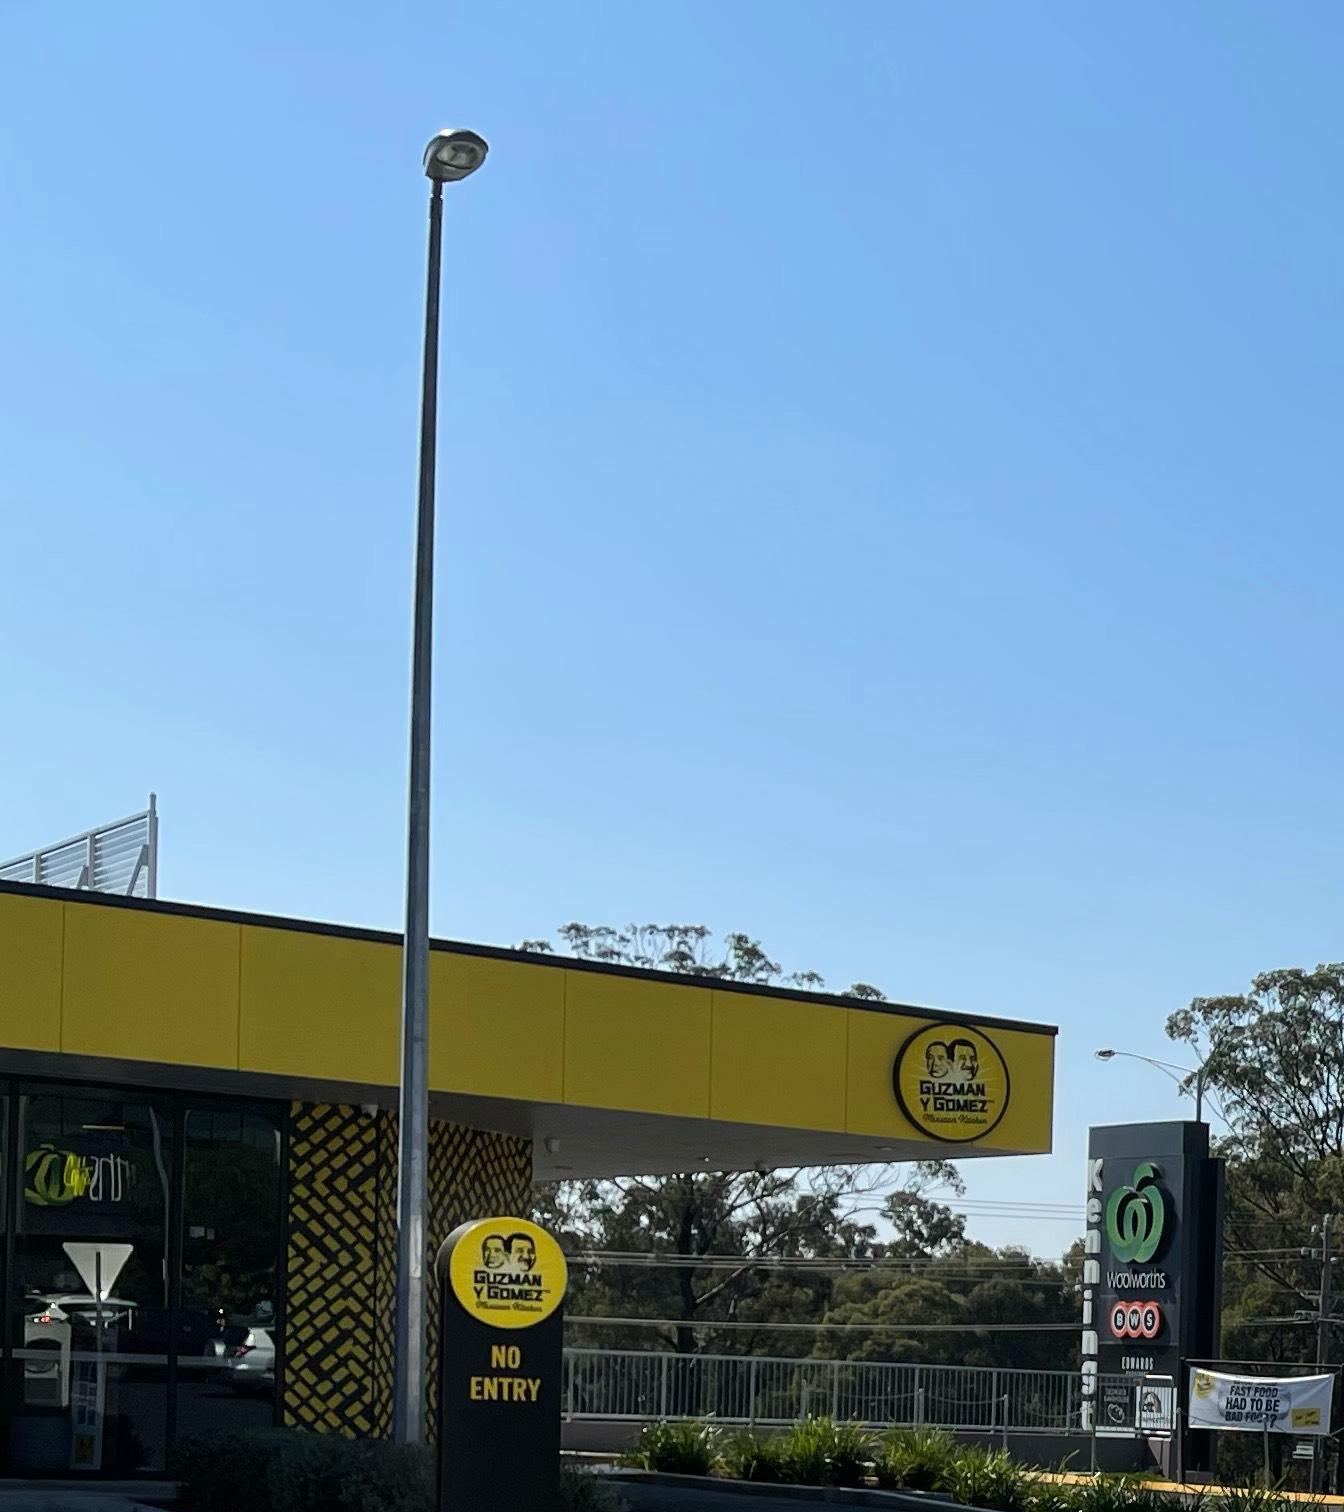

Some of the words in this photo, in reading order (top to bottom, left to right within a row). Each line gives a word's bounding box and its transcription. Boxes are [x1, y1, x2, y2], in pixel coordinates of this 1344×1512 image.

[919, 1080, 985, 1096] GUZMAN
[920, 1098, 931, 1112] Y
[934, 1097, 988, 1112] GOMEZ
[473, 1270, 542, 1287] GUZMAN
[473, 1286, 485, 1300] Y
[488, 1286, 543, 1301] GOMEZ
[1116, 1312, 1156, 1327] BWS
[491, 1345, 521, 1369] NO
[470, 1376, 541, 1402] ENTRY
[1230, 1386, 1251, 1397] FAST
[1254, 1387, 1279, 1398] FOOD
[1225, 1397, 1246, 1410] HAD
[1251, 1399, 1263, 1411] TO
[1265, 1400, 1280, 1412] BE
[1225, 1411, 1243, 1422] BAD
